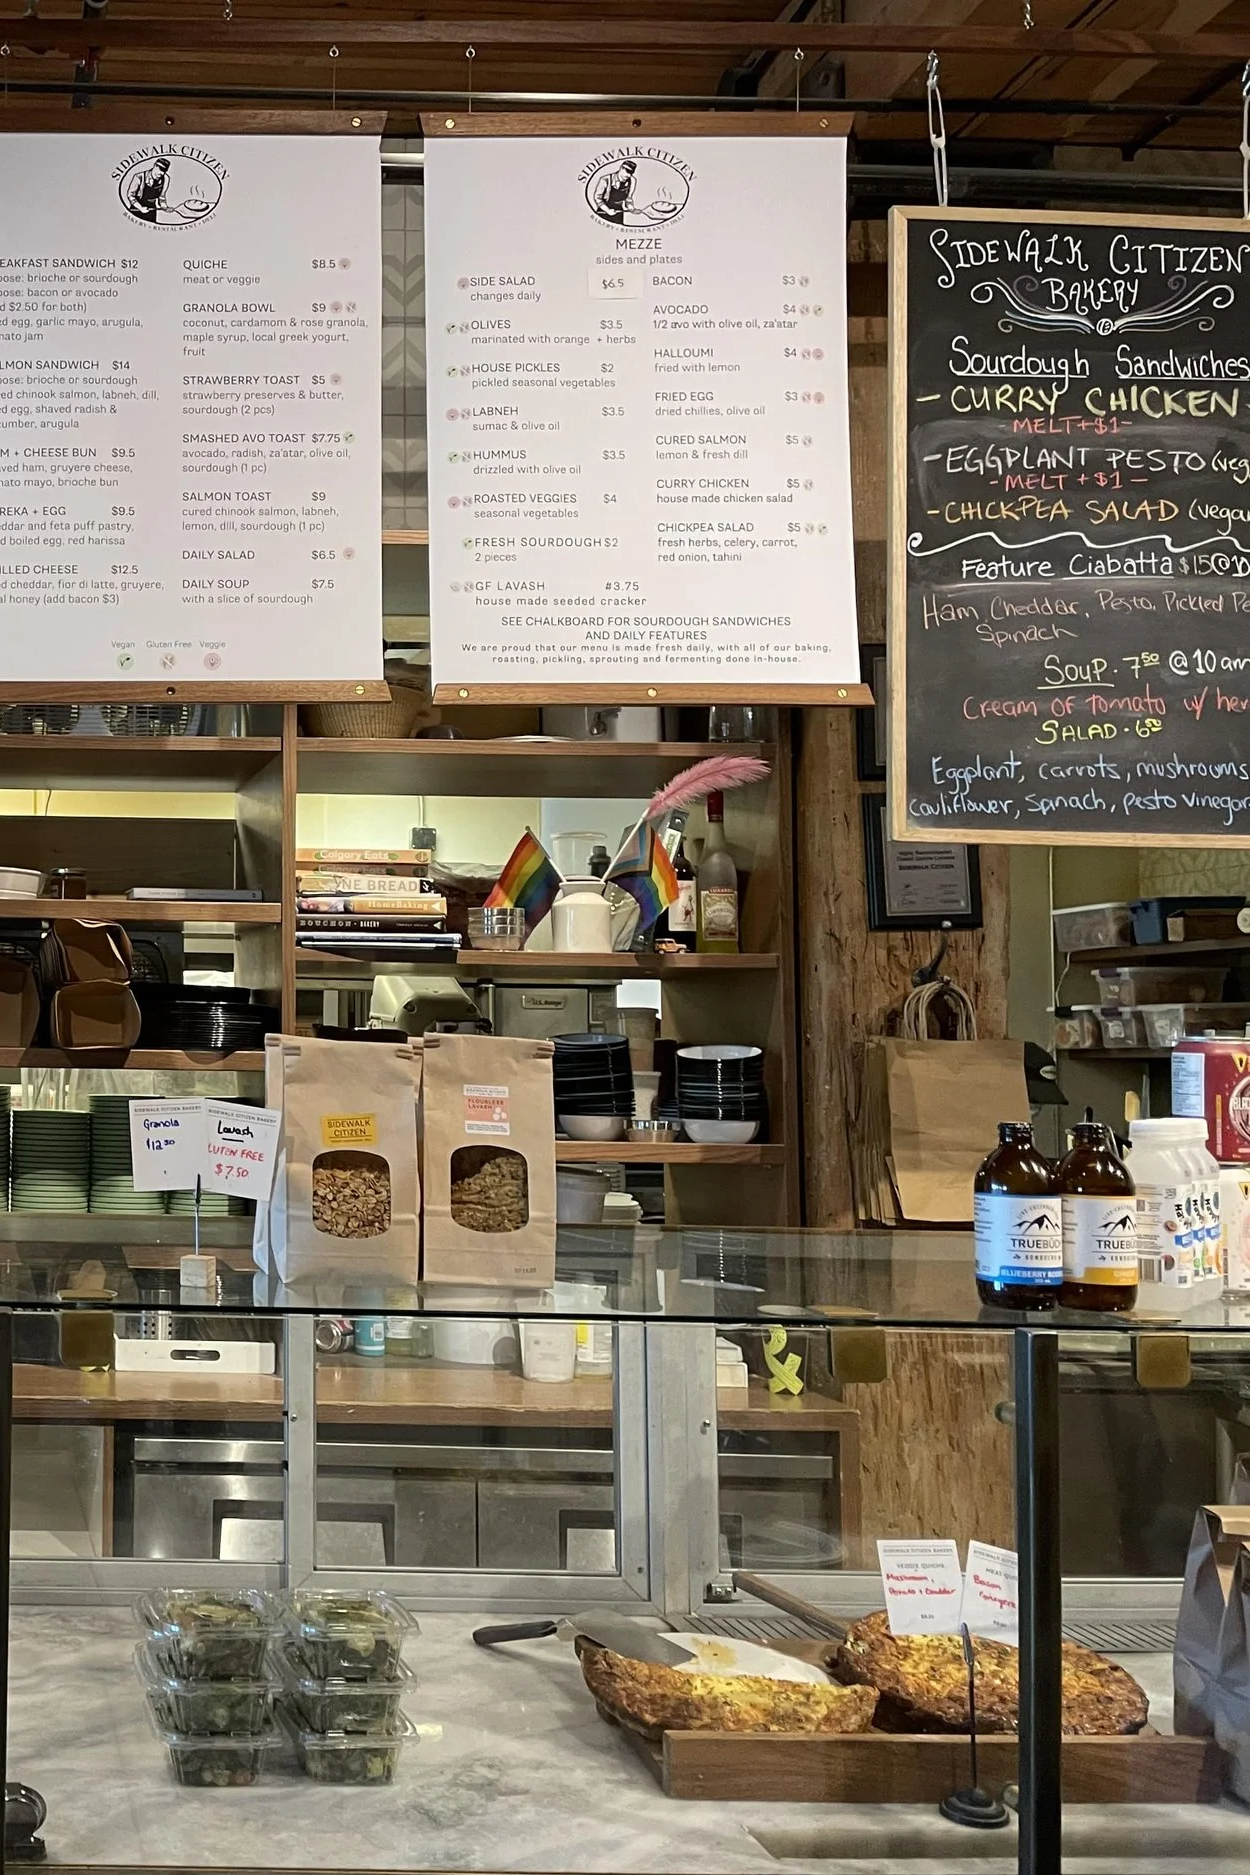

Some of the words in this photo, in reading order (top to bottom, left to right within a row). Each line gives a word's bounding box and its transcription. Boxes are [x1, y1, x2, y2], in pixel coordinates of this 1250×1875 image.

[111, 144, 177, 181] SIDEWALK
[181, 145, 230, 180] CITIZEN
[578, 146, 644, 184] SIDEWALK
[647, 147, 698, 181] CITIZEN
[616, 238, 662, 250] MEZZE
[596, 255, 623, 264] sides
[627, 255, 646, 264] and
[650, 255, 682, 266] plates
[930, 228, 1089, 289] SIDEWALK
[1109, 234, 1250, 275] CITIZEN
[53, 259, 115, 268] SANDWICH
[121, 259, 138, 269] $12
[183, 260, 227, 271] QUICHE
[312, 259, 335, 269] $8.5
[470, 277, 495, 286] SIDE
[499, 276, 535, 285] SALAD
[653, 276, 692, 285] BACON
[783, 276, 795, 285] $3
[1041, 277, 1139, 316] BAKERY
[183, 304, 238, 312] GRANOLA
[242, 303, 276, 312] BOWL
[312, 303, 326, 312] $9
[653, 305, 708, 314] AVOCADO
[783, 304, 796, 314] $4
[471, 320, 510, 329] OLIVES
[600, 320, 622, 329] $3.5
[654, 348, 713, 358] HALLOUMI
[784, 348, 796, 357] $4
[36, 360, 99, 370] SANDWICH
[112, 361, 130, 370] $14
[472, 363, 511, 373] HOUSE
[516, 363, 560, 372] PICKLES
[601, 363, 613, 373] $2
[949, 335, 1090, 395] Sourdough
[1115, 343, 1250, 380] Sandwiches
[183, 376, 260, 385] STRAWBERRY
[263, 375, 300, 384] TOAST
[312, 375, 325, 385] $5
[655, 392, 687, 401] FRIED
[690, 392, 713, 401] EGG
[785, 391, 797, 401] $3
[951, 384, 1058, 416] CURRY
[1085, 384, 1240, 419] CHICKEN
[473, 406, 518, 416] LABNEH
[602, 407, 624, 416] $3.5
[183, 434, 239, 443] SMASHED
[242, 434, 265, 443] AVO
[268, 434, 306, 443] TOAST
[312, 433, 340, 443] $7.75
[656, 435, 695, 445] CURED
[698, 435, 746, 444] SALMON
[786, 435, 798, 445] $5
[24, 448, 68, 457] CHEESE
[73, 448, 96, 457] BUN
[112, 448, 135, 457] $9.5
[473, 450, 526, 459] HUMMUS
[603, 450, 625, 460] $3.5
[946, 444, 1090, 476] EGGPLANT
[1104, 448, 1207, 475] PESTO
[657, 479, 695, 488] CURRY
[699, 479, 749, 488] CHICKEN
[787, 478, 800, 488] $5
[1005, 473, 1069, 492] MELT
[183, 492, 231, 501] SALMON
[235, 492, 271, 501] TOAST
[312, 492, 326, 501] $9
[474, 493, 526, 503] ROASTED
[529, 494, 576, 503] VEGGIES
[604, 494, 616, 504] $4
[43, 506, 66, 515] EGG
[112, 506, 135, 516] $9.5
[945, 495, 1074, 524] CHICKPEA
[1085, 499, 1180, 525] SALAD
[658, 523, 714, 532] CHICKPEA
[718, 523, 754, 532] SALAD
[788, 522, 801, 532] $5
[475, 538, 515, 547] FRESH
[521, 537, 601, 547] SOURDOUGH
[604, 538, 618, 548] $2
[183, 550, 214, 559] DAILY
[218, 550, 255, 559] SALAD
[311, 550, 335, 560] $6.5
[33, 565, 78, 574] CHEESE
[111, 565, 138, 574] $12.5
[962, 555, 1055, 580] Feature
[1069, 551, 1174, 576] Ciabatta
[183, 579, 214, 589] DAILY
[218, 580, 249, 589] SOUP
[312, 579, 334, 589] $7.5
[476, 581, 491, 591] GF
[497, 581, 544, 591] LAVASH
[605, 582, 639, 591] #3.75
[1162, 590, 1225, 613] Pickled
[502, 617, 522, 626] SEE
[526, 617, 604, 626] CHALKBOARD
[608, 617, 630, 626] FOR
[634, 617, 709, 626] SOURDOUGH
[713, 617, 791, 626] SANDWICHES
[585, 631, 610, 640] AND
[614, 631, 645, 640] DAILY
[649, 631, 707, 640] FEATURES
[963, 696, 1037, 720] Cream
[1035, 720, 1117, 744] SALAD
[320, 850, 361, 861] Calgary
[364, 850, 389, 860] Eats
[368, 880, 417, 891] BREAD
[143, 1118, 180, 1130] Granola
[217, 1120, 254, 1138] Lavash
[327, 1120, 371, 1128] SIDEWALK
[333, 1128, 366, 1136] CITIZEN
[241, 1150, 265, 1162] FREE
